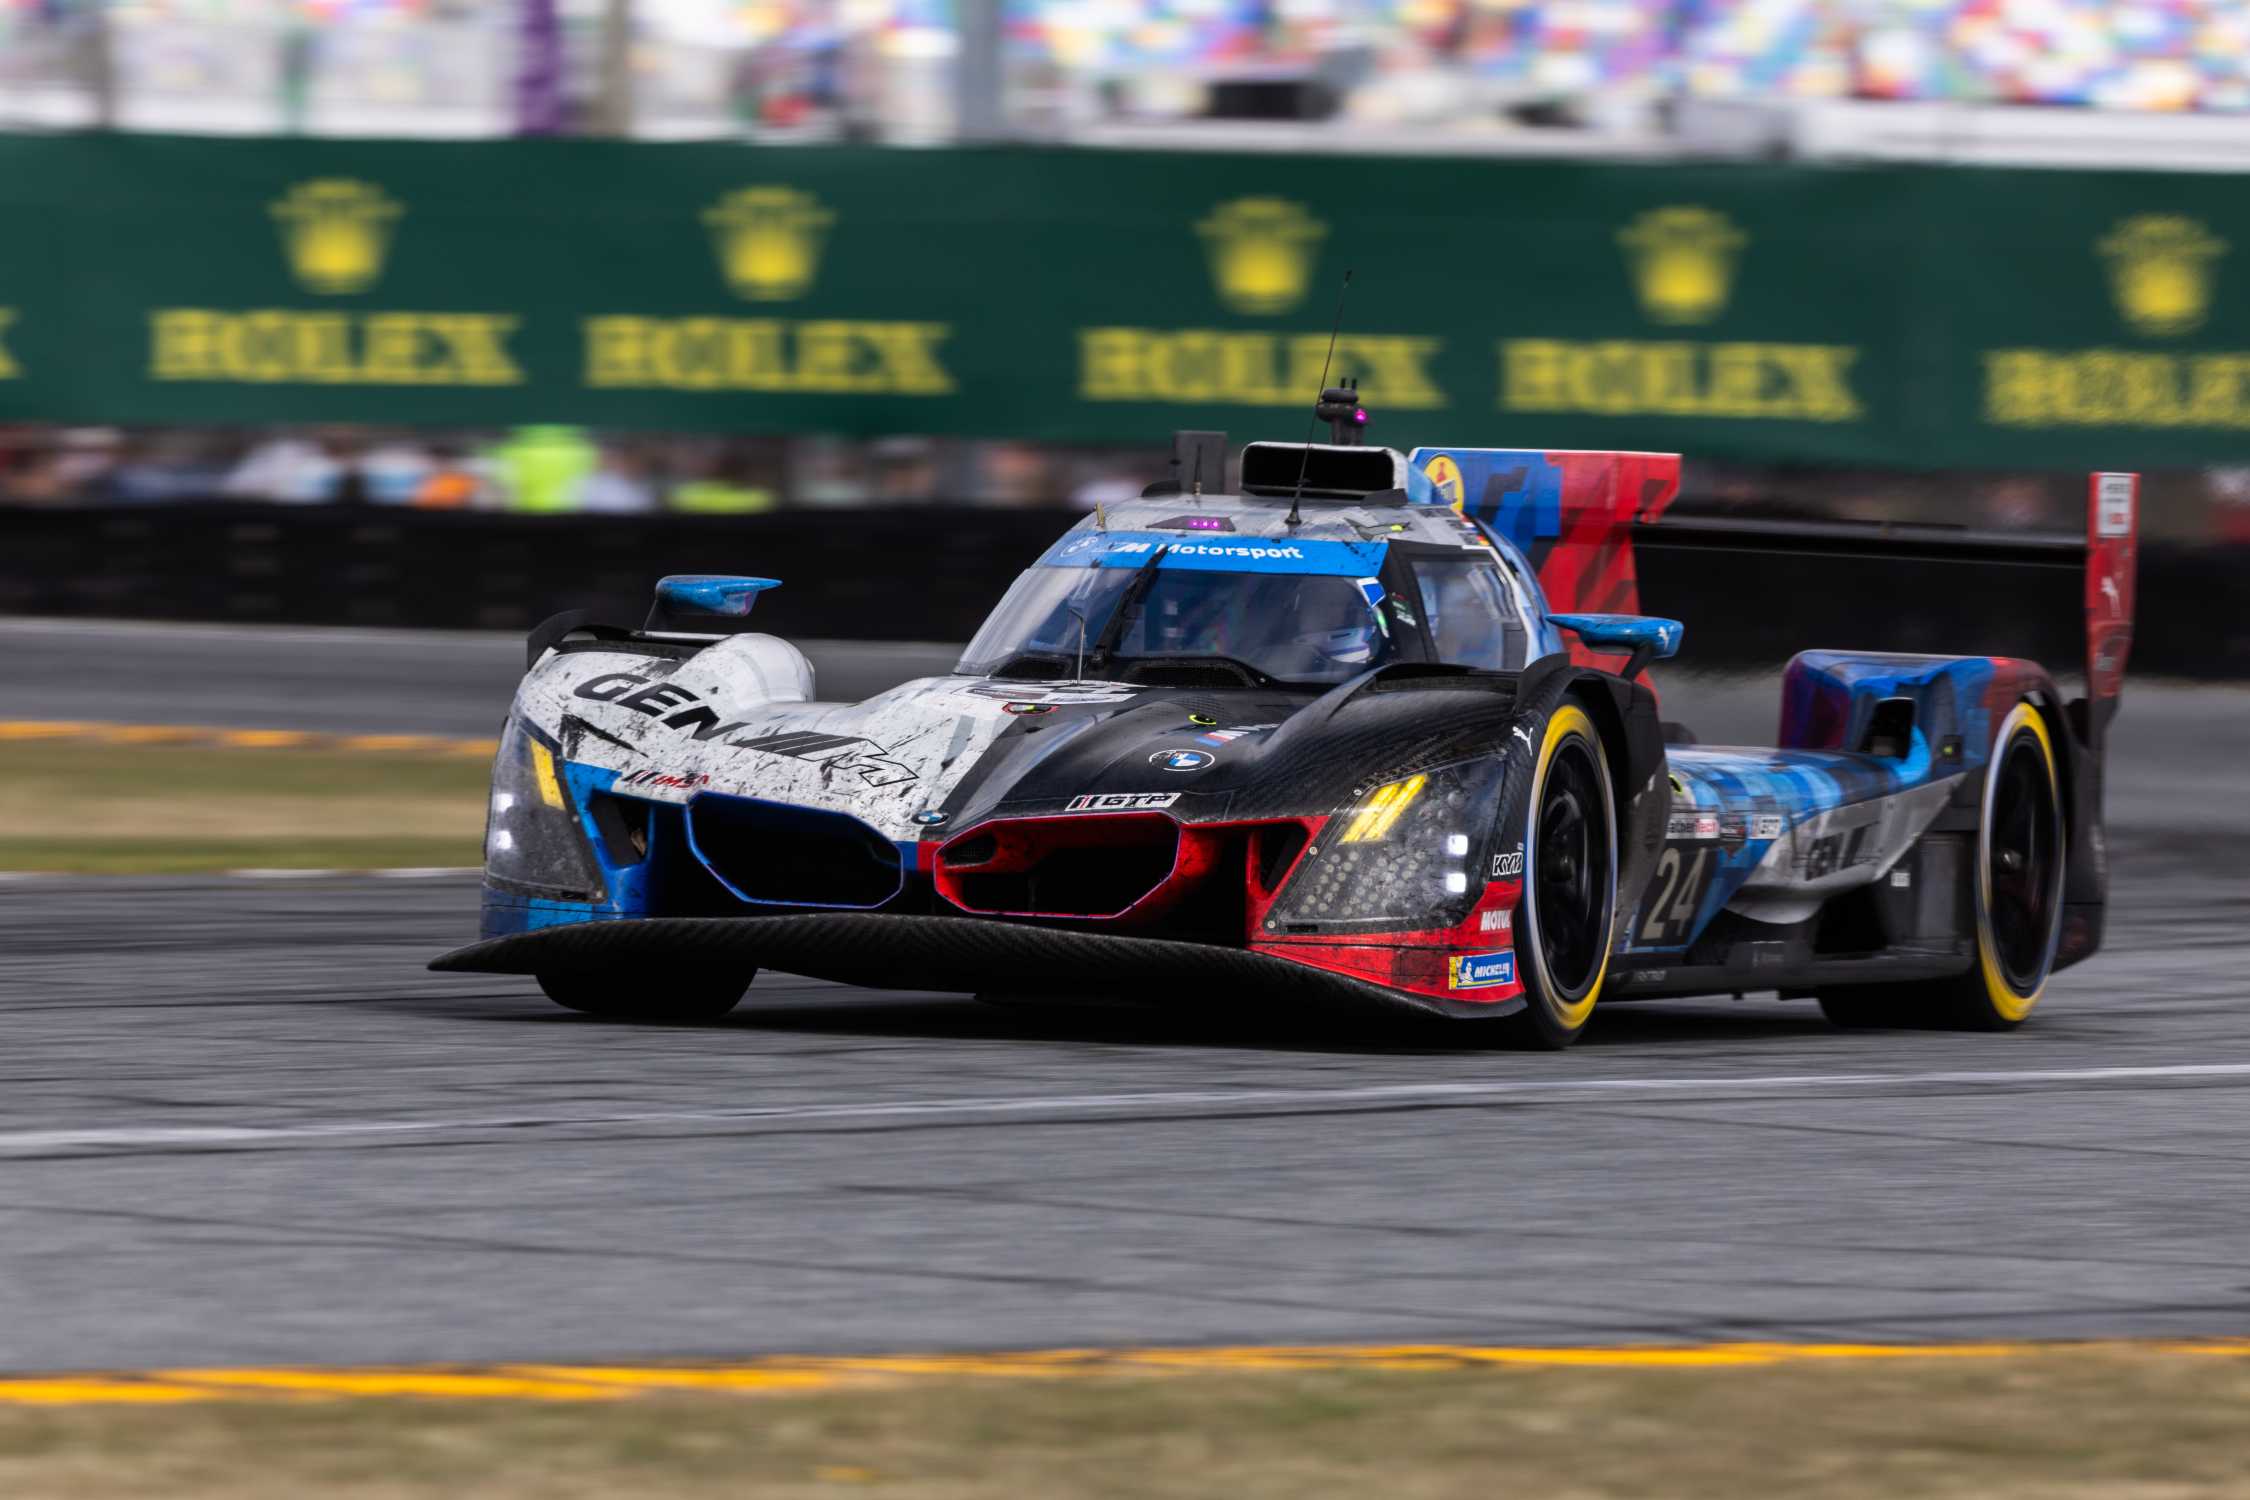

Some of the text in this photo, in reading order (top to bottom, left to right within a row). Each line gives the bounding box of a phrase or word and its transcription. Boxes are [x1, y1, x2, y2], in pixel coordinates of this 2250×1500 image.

[151, 309, 520, 385] ROLEX
[586, 315, 951, 392] ROLEX
[1081, 327, 1441, 405] ROLEX
[1502, 338, 1857, 419] ROLEX
[1157, 543, 1304, 560] Motorsport
[1102, 794, 1173, 806] GTP
[1492, 852, 1523, 876] KYB
[1641, 847, 1706, 940] 24
[1480, 909, 1512, 931] MOTUL
[1474, 962, 1511, 979] MICHELIN
